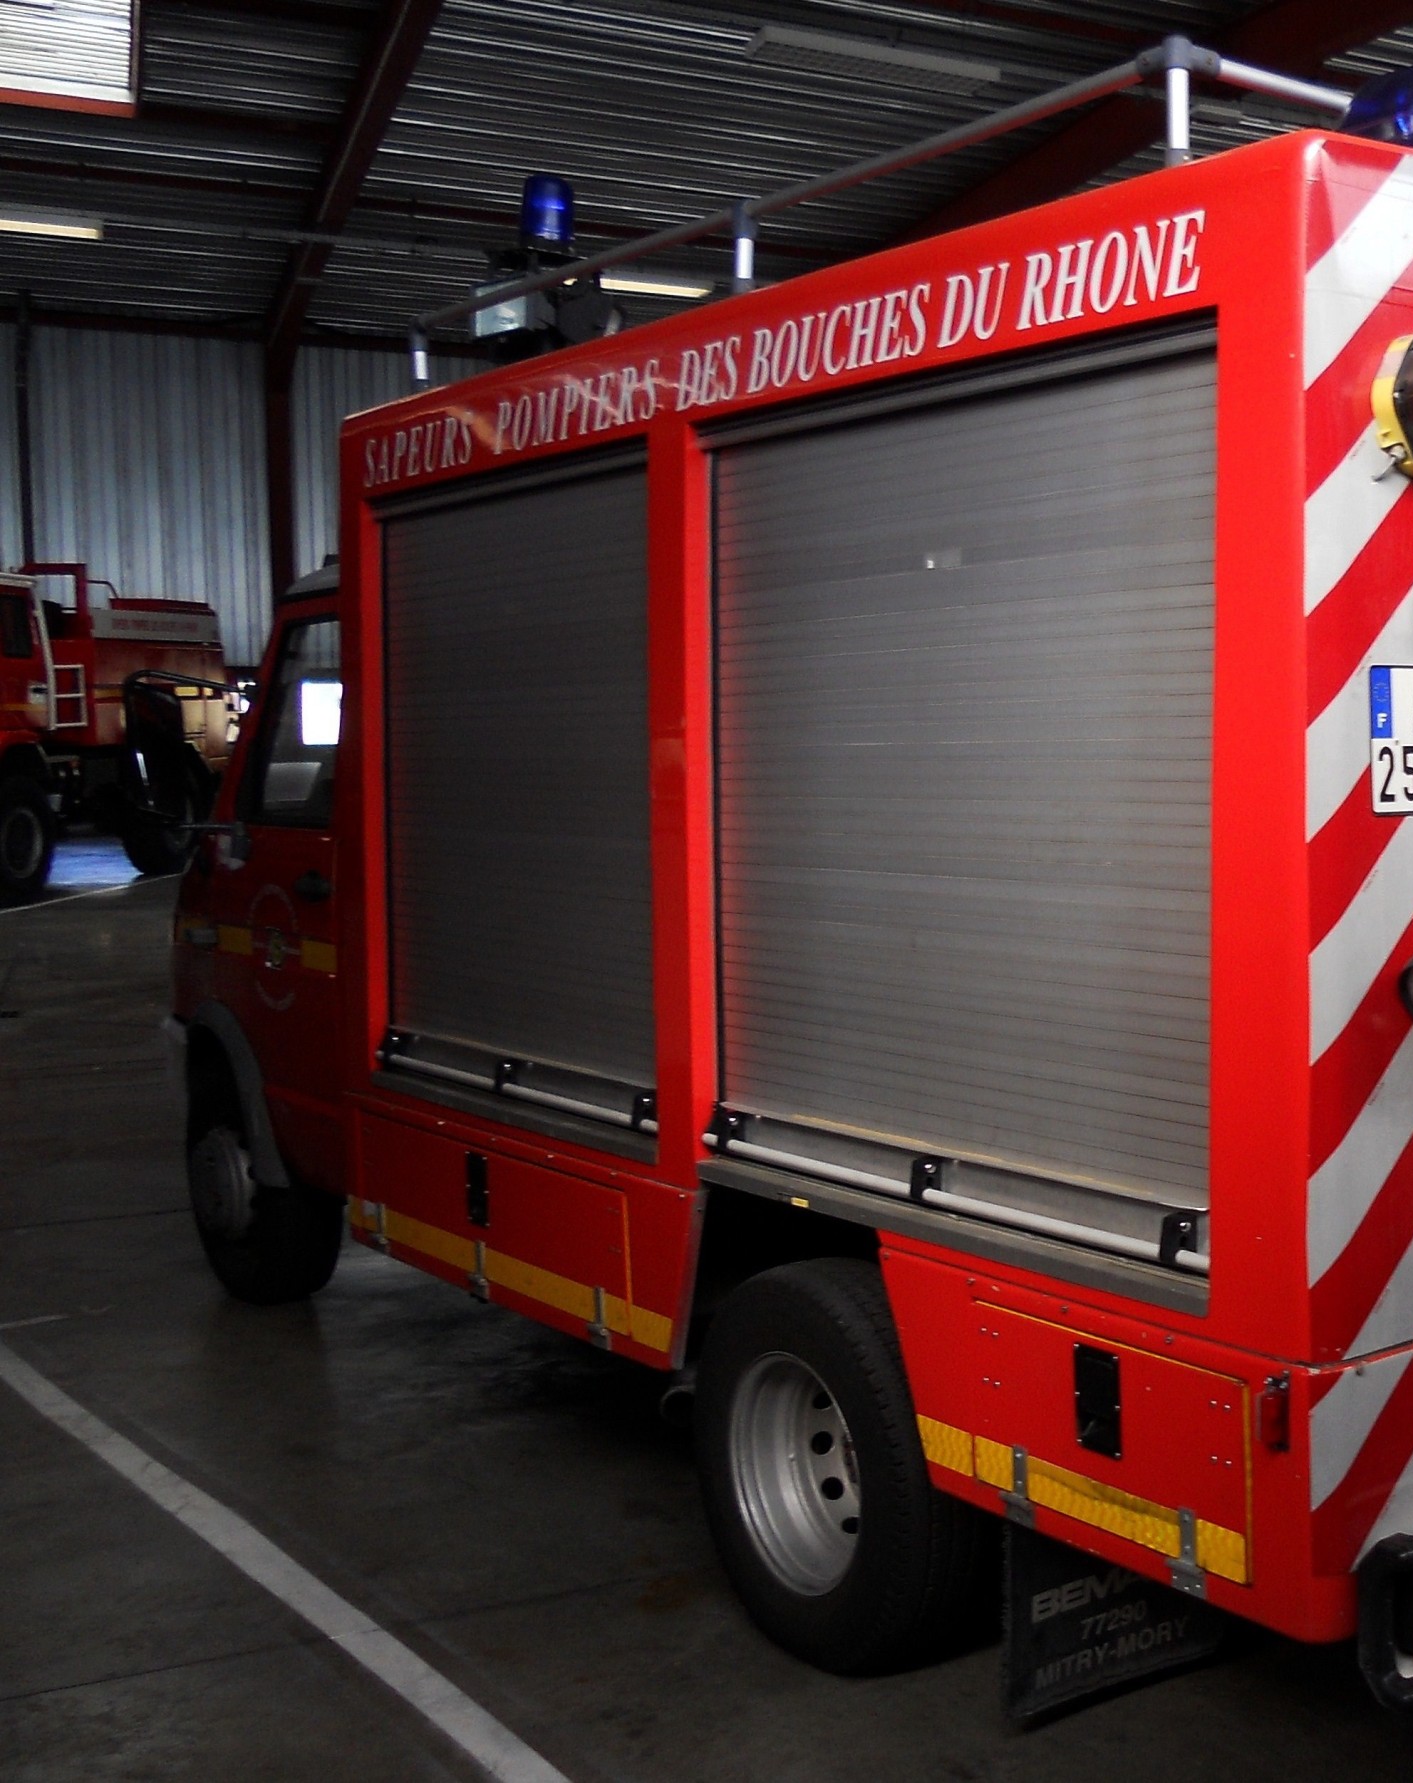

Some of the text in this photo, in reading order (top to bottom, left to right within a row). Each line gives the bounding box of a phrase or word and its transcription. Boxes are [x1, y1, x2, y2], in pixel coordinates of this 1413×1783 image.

[364, 210, 1206, 488] SAPEURS POMPIERS DES BOUCHES DU RHONE
[1377, 713, 1388, 729] F
[1080, 1600, 1148, 1640] 77290
[1034, 1616, 1188, 1690] MITRY-MORY
